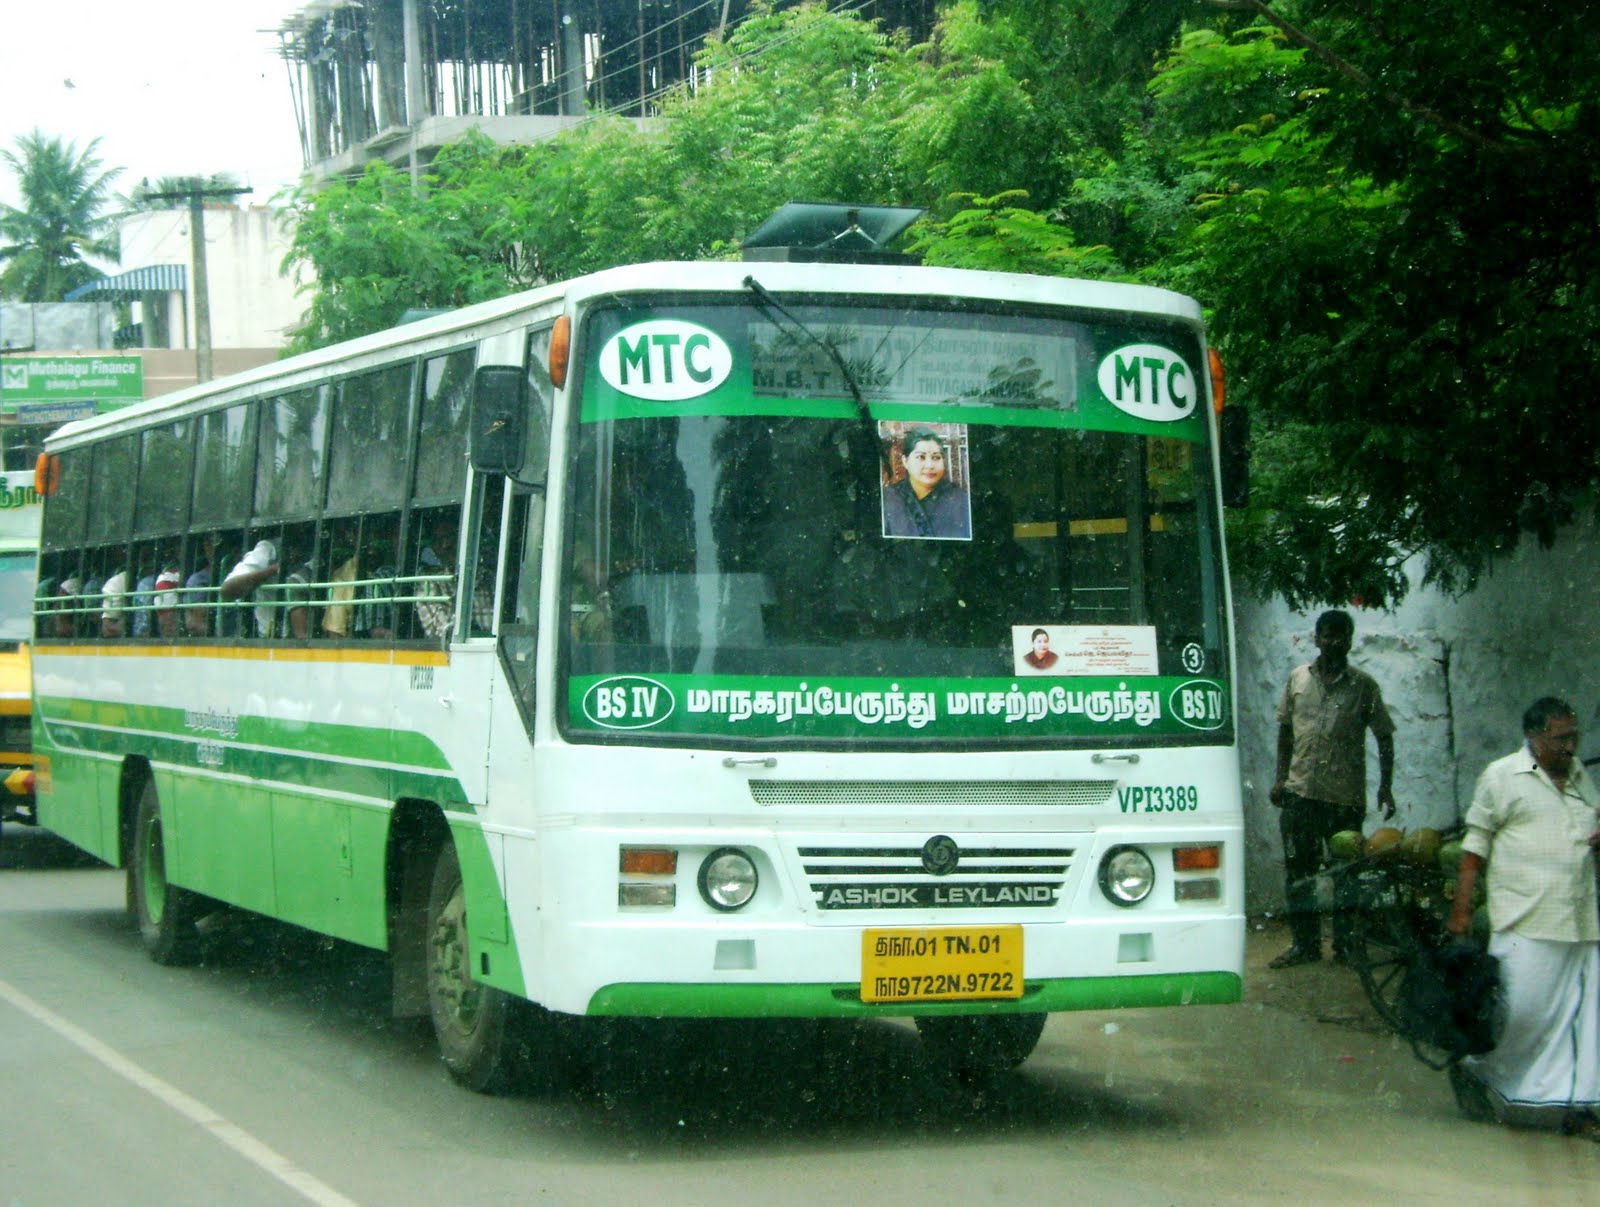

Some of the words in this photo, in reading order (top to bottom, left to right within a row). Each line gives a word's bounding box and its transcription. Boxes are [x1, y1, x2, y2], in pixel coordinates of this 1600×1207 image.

[29, 361, 89, 378] Muthalagu
[91, 359, 136, 374] Finance
[618, 333, 713, 385] MTC
[1115, 354, 1187, 410] MTC
[1188, 648, 1199, 668] 3
[597, 686, 627, 719] BS
[631, 687, 659, 718] IV
[687, 682, 936, 729] மாநகரப்பேருந்து
[947, 682, 1161, 726] மாசற்றபேருந்து
[1182, 689, 1205, 719] BS
[1207, 691, 1221, 719] IV
[1117, 785, 1198, 813] VPI3389
[827, 888, 918, 904] ASHOK
[934, 886, 1051, 903] LEYLAND
